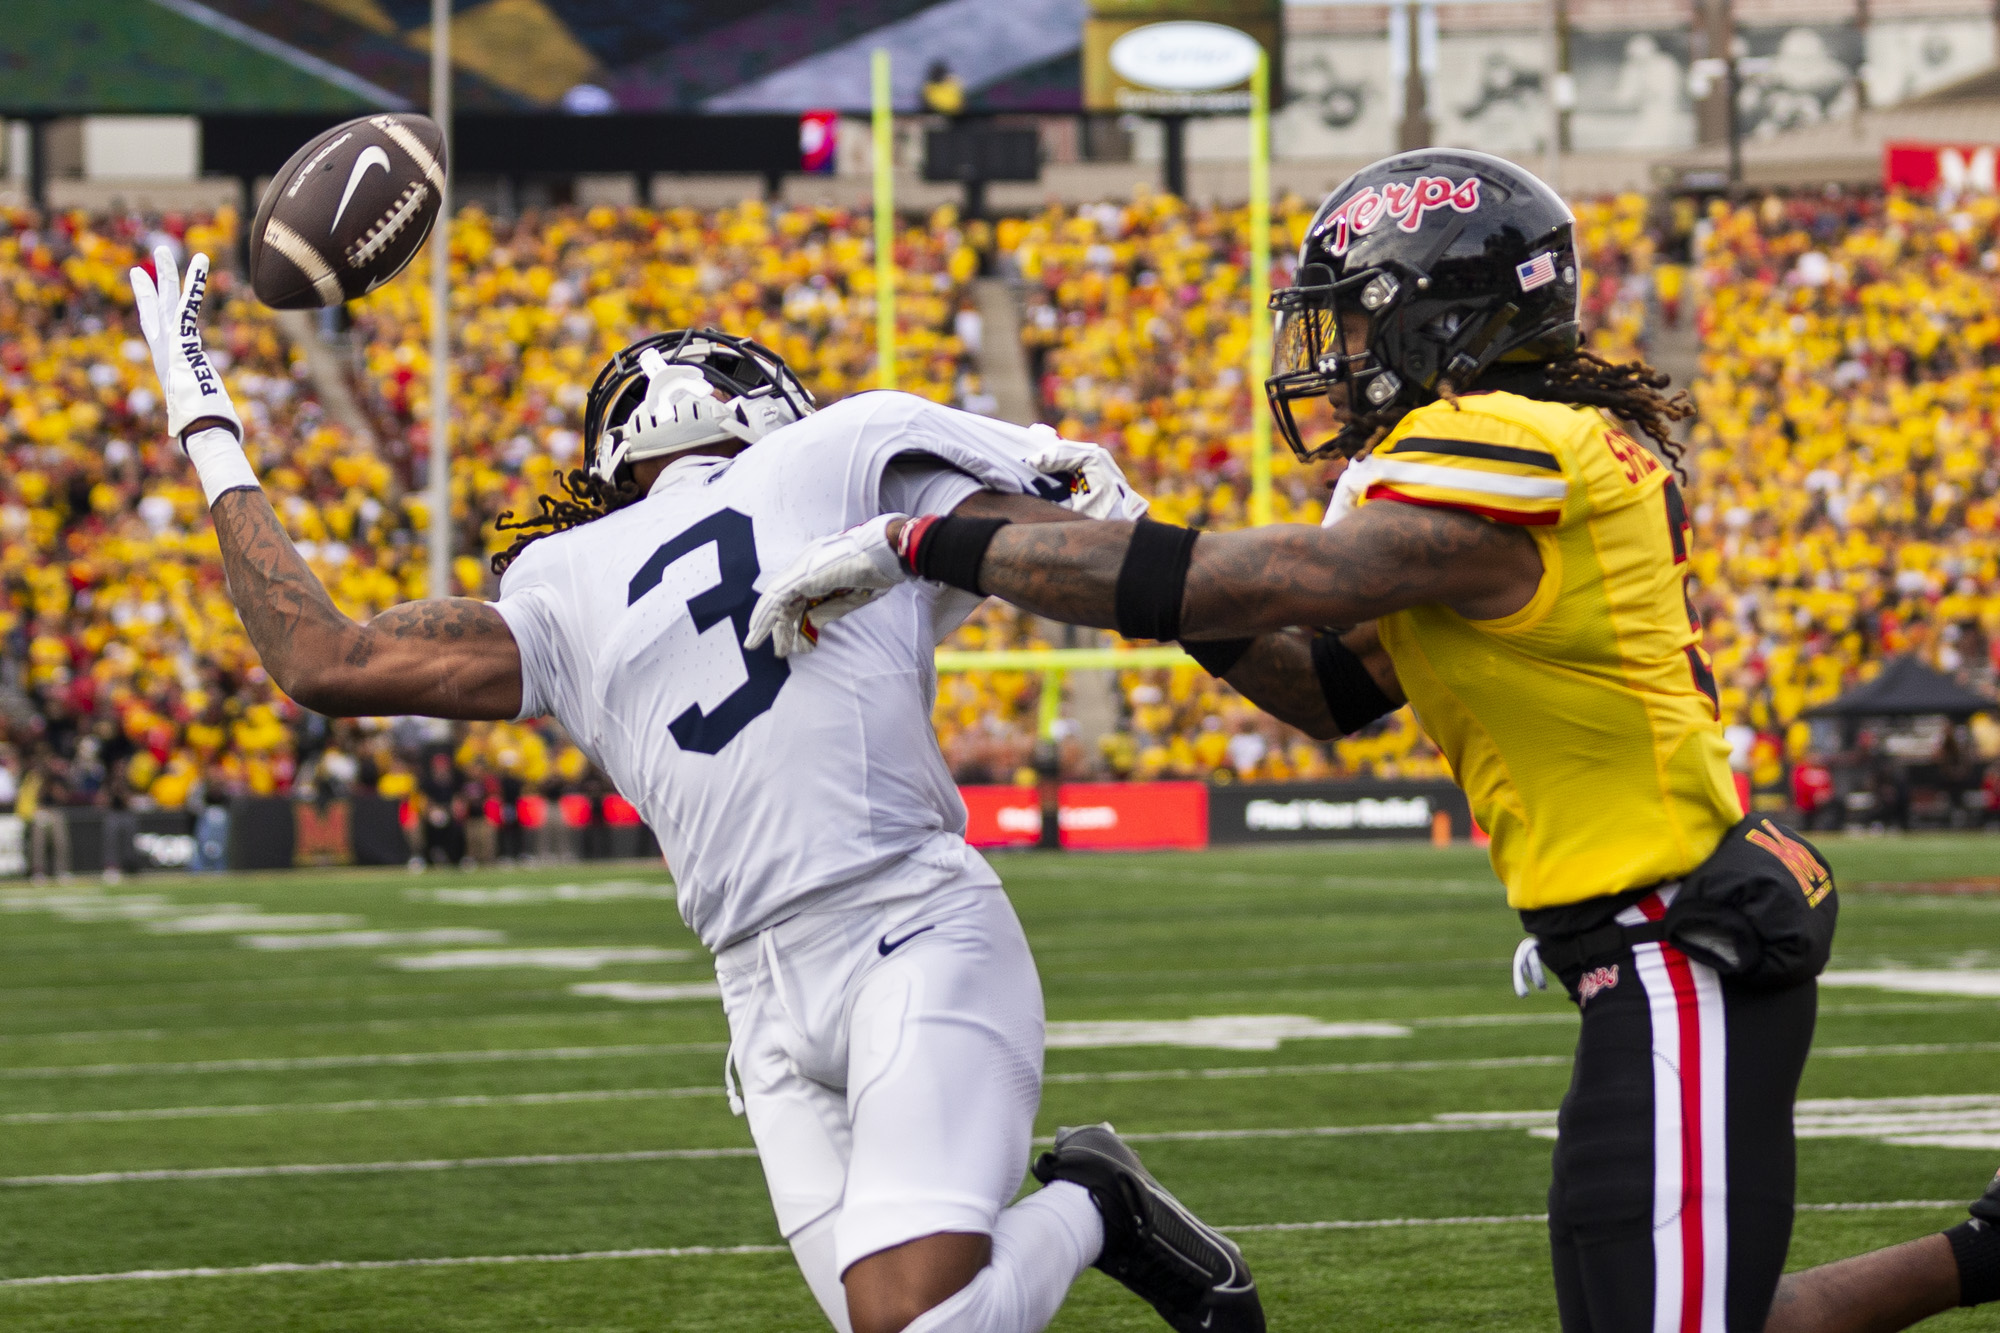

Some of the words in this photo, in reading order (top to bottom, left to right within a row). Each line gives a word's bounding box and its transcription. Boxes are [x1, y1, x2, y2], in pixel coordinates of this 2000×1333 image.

[1324, 176, 1481, 257] Terps
[180, 268, 207, 337] STATE
[182, 341, 218, 397] PENN
[627, 506, 792, 756] 3
